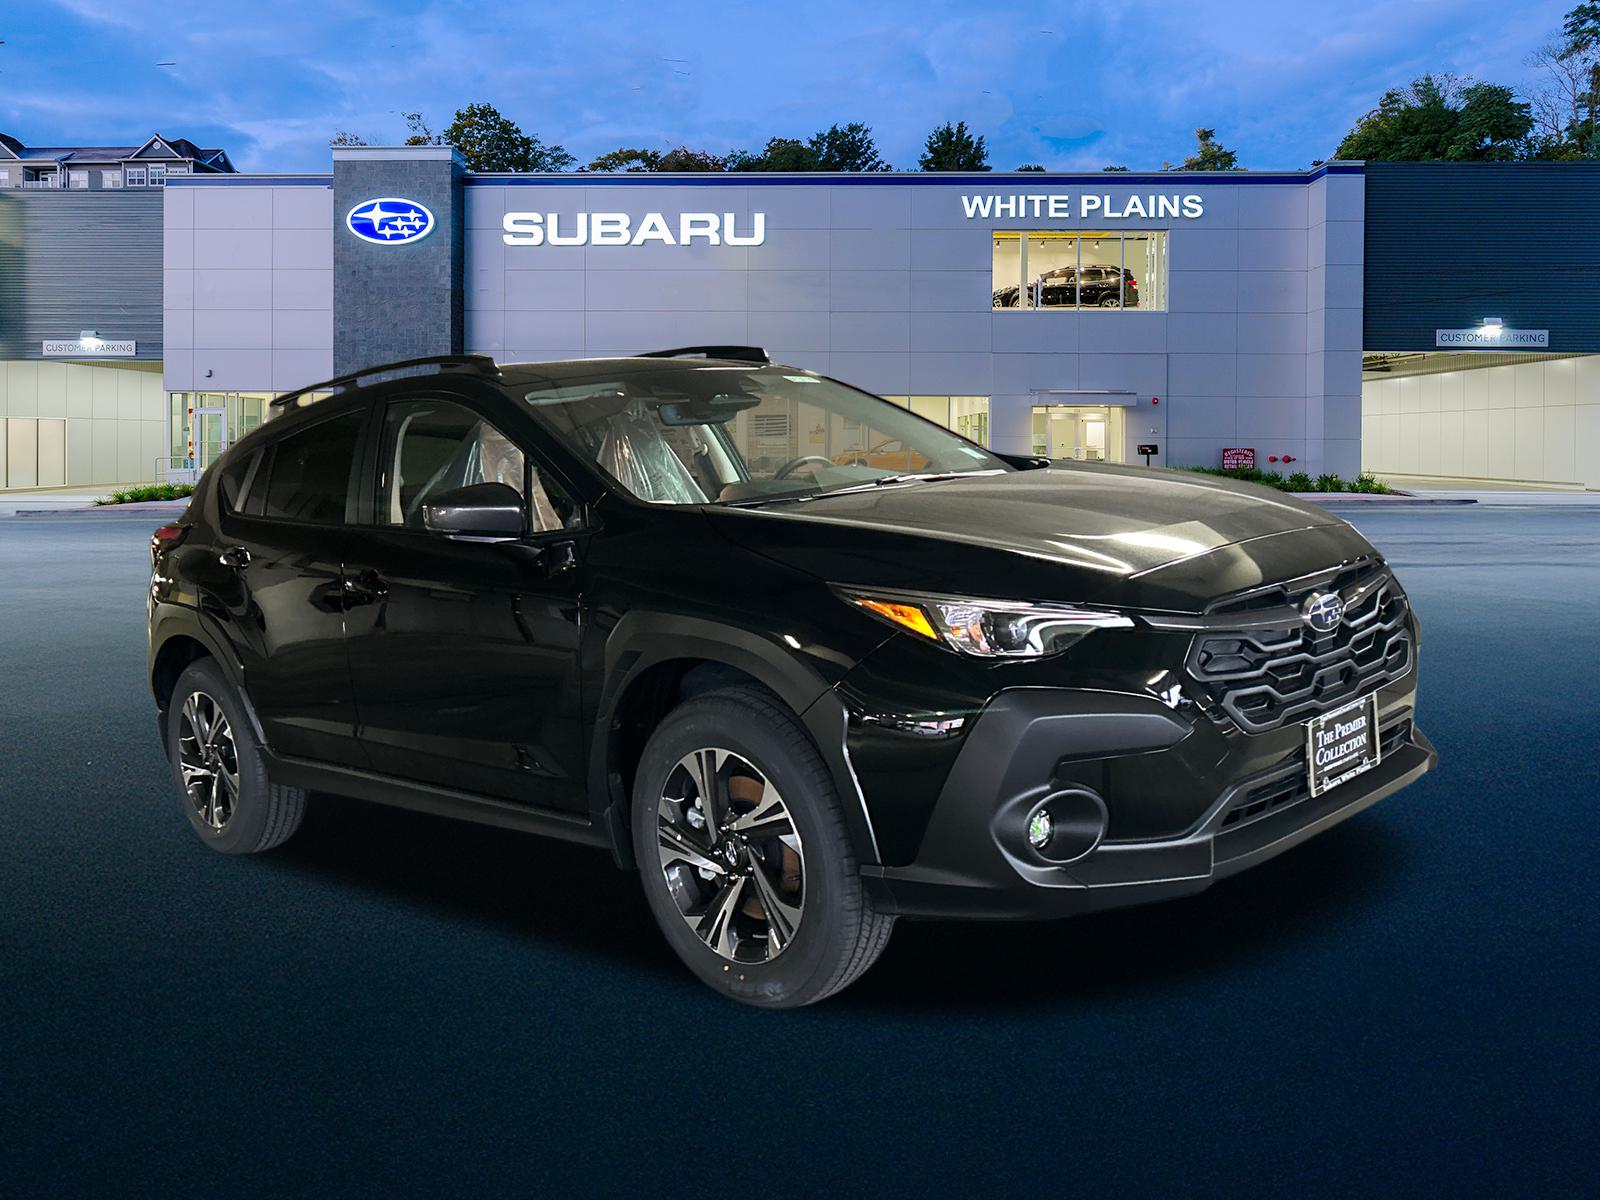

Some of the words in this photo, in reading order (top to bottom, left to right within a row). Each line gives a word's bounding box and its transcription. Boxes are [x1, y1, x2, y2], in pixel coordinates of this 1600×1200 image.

[961, 195, 1069, 218] WHITE
[1080, 194, 1204, 218] PLAINS
[503, 212, 765, 246] SUBARU
[95, 344, 133, 352] PARKING
[1440, 333, 1496, 343] CUSTOMER
[1501, 333, 1545, 343] PARKING
[1316, 730, 1334, 748] THE
[1335, 716, 1367, 740] PREMIER
[1315, 732, 1367, 766] COLLECTION
